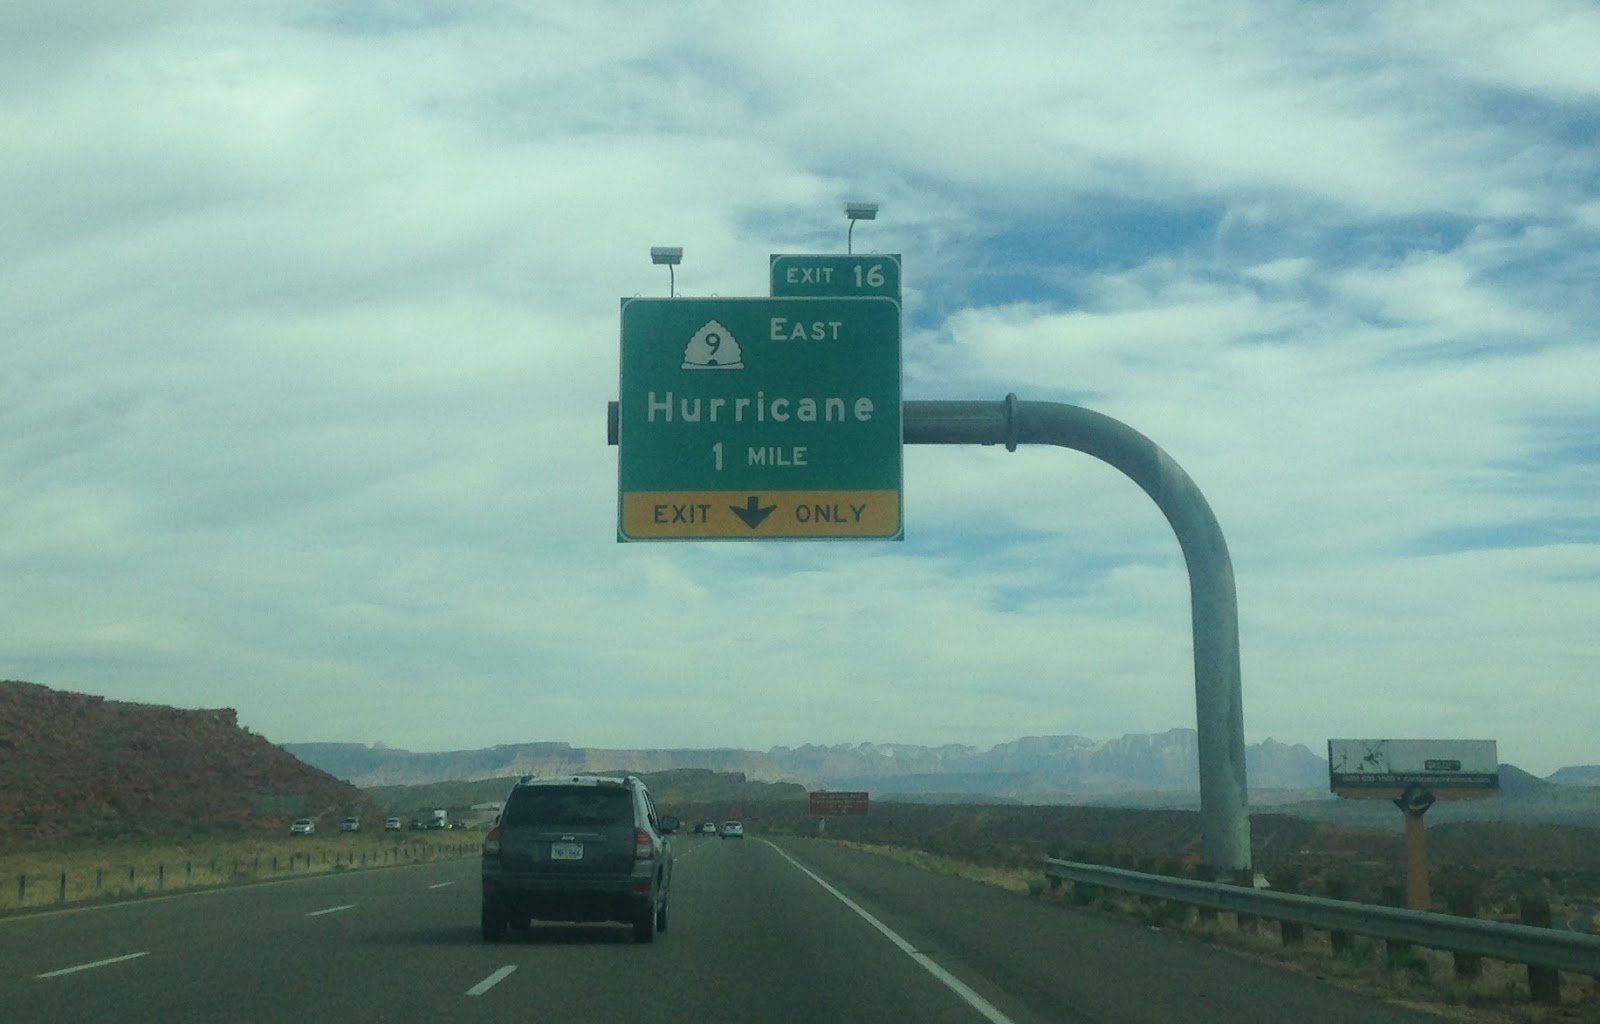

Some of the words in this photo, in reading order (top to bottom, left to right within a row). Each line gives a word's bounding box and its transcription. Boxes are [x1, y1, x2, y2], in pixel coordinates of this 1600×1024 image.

[786, 267, 834, 284] EXIT
[853, 264, 885, 287] 16
[770, 317, 842, 341] EAST
[705, 332, 721, 355] 9
[647, 390, 874, 422] Hurricane
[712, 442, 723, 471] 1
[748, 446, 808, 466] MILE
[653, 504, 712, 524] EXIT
[795, 503, 866, 523] ONLY
